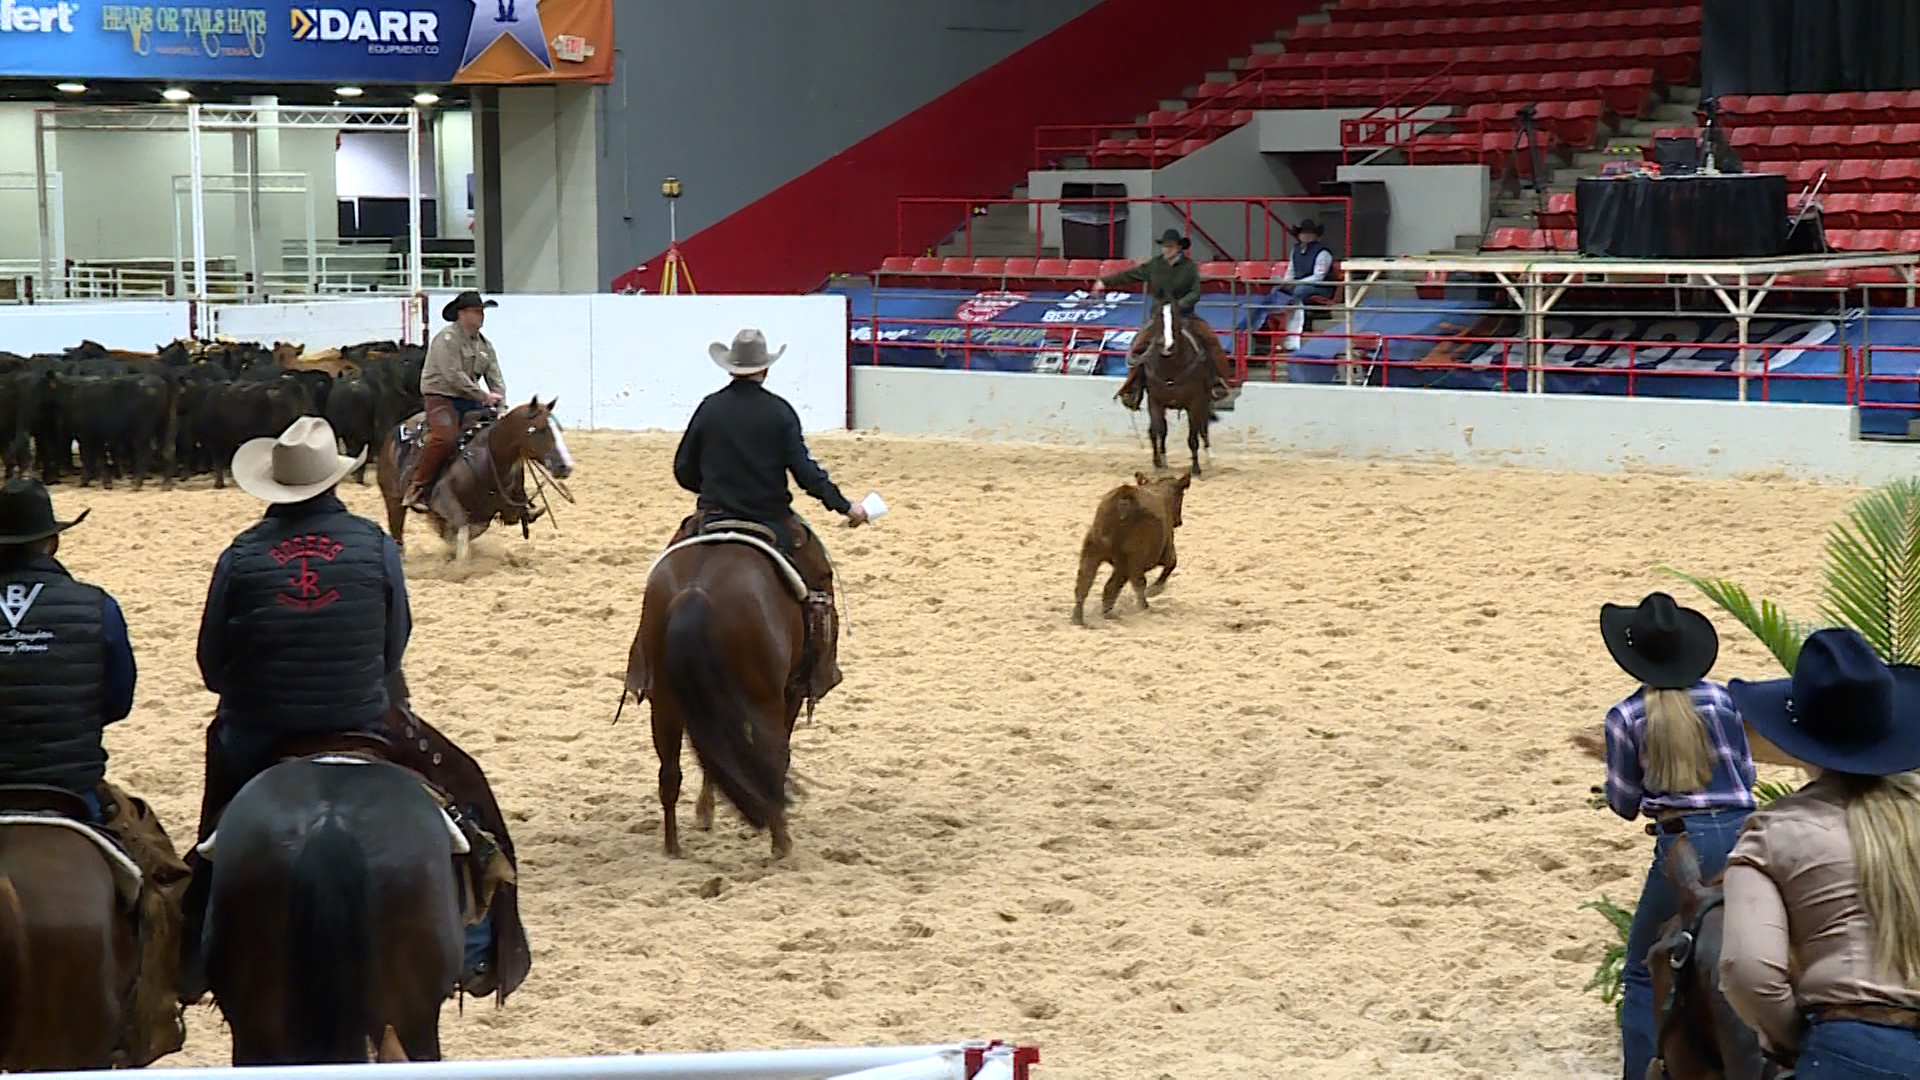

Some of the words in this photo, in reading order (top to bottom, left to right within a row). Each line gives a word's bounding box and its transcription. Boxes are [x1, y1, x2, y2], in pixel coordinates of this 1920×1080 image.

[102, 5, 153, 54] HEADS
[156, 7, 179, 32] OR
[181, 8, 225, 55] TAILS
[227, 9, 266, 55] HATS
[320, 9, 438, 42] DARR
